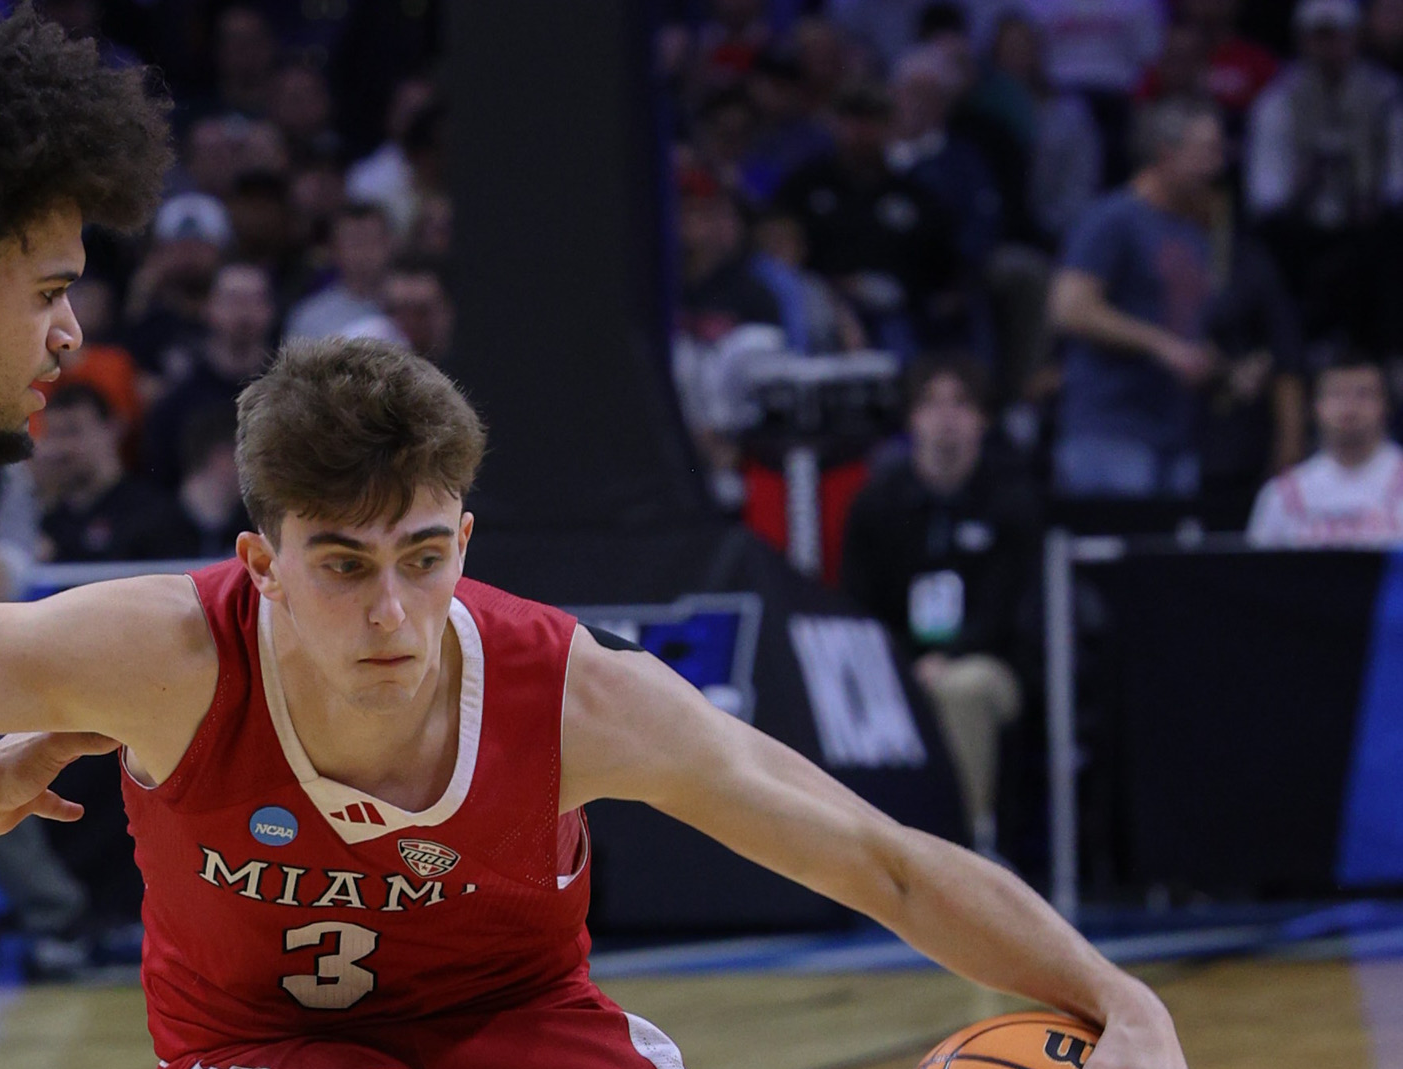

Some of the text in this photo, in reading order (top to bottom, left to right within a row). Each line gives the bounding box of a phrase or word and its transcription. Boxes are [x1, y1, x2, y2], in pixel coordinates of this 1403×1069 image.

[254, 822, 294, 840] NCAA
[400, 848, 454, 870] MAC
[281, 921, 381, 1010] 3
